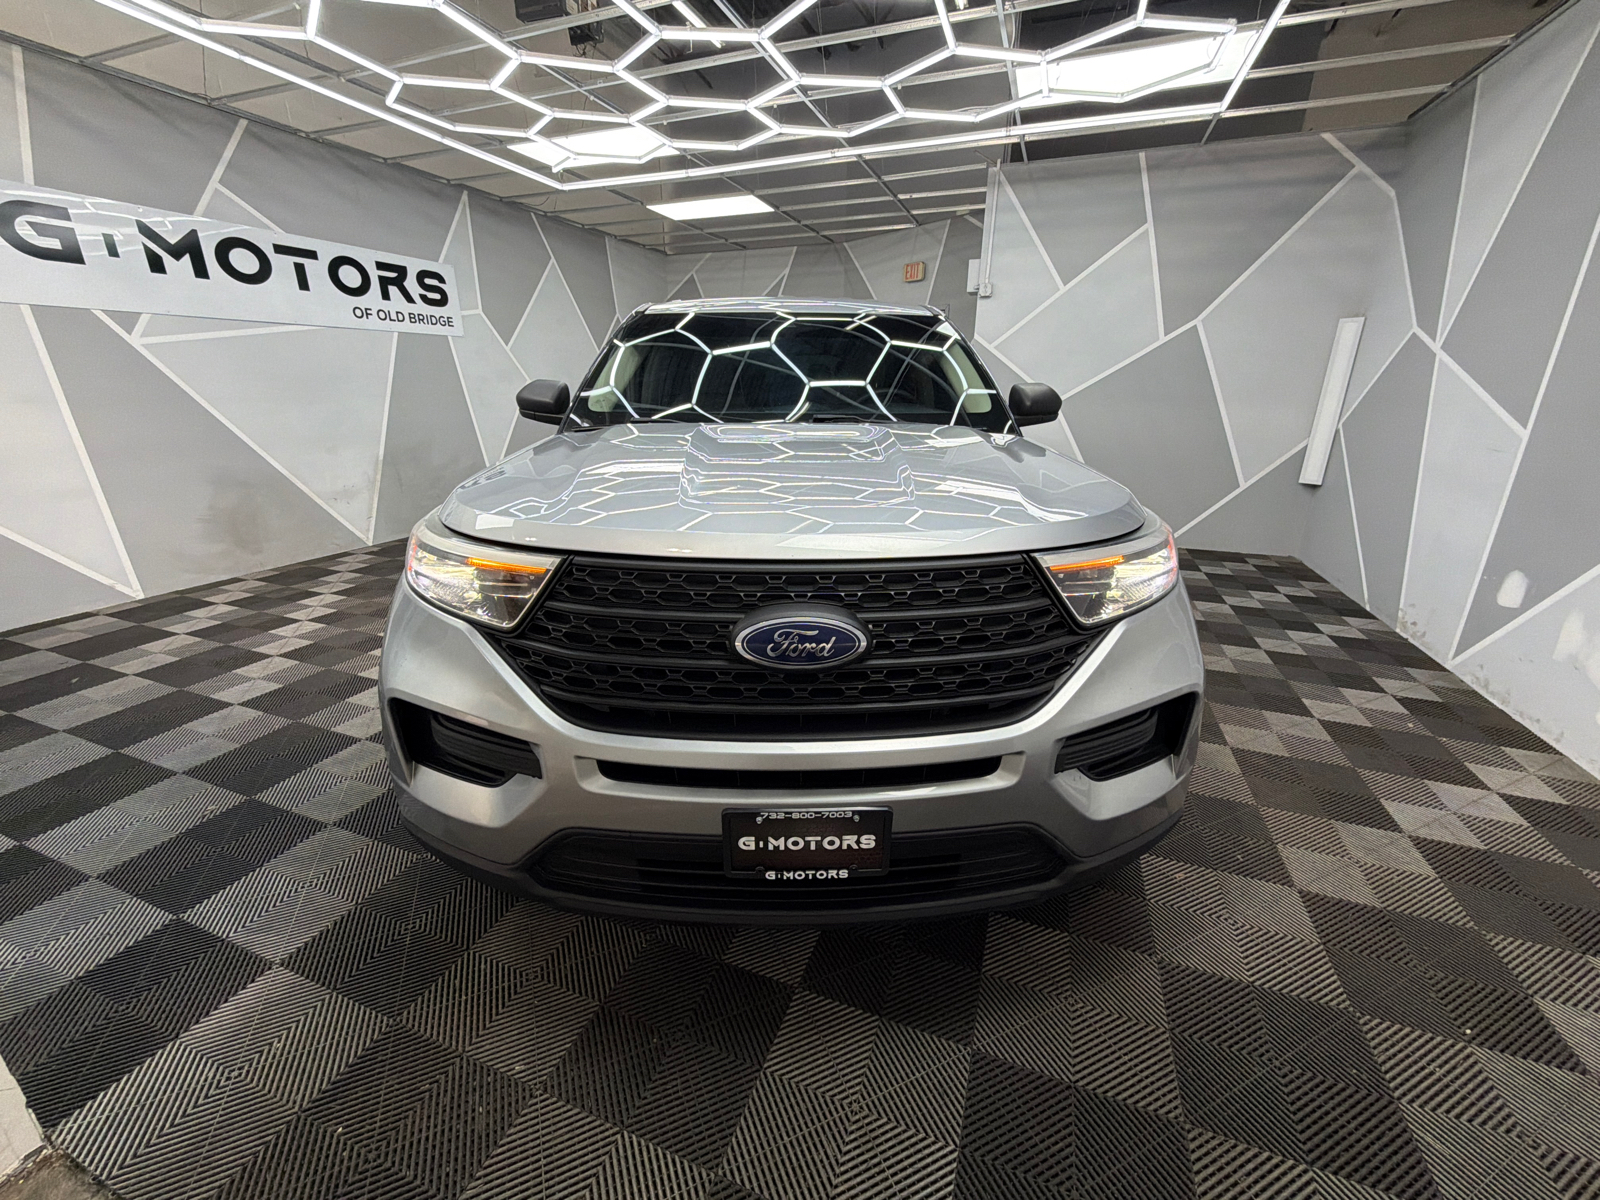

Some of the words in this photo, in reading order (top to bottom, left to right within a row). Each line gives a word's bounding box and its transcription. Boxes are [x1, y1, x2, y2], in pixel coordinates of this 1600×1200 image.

[905, 262, 921, 280] EXIT
[352, 306, 373, 320] OF
[376, 309, 406, 322] OLD
[408, 312, 455, 328] BRIDGE
[766, 628, 837, 658] Ford
[760, 811, 853, 820] 732-800-7003
